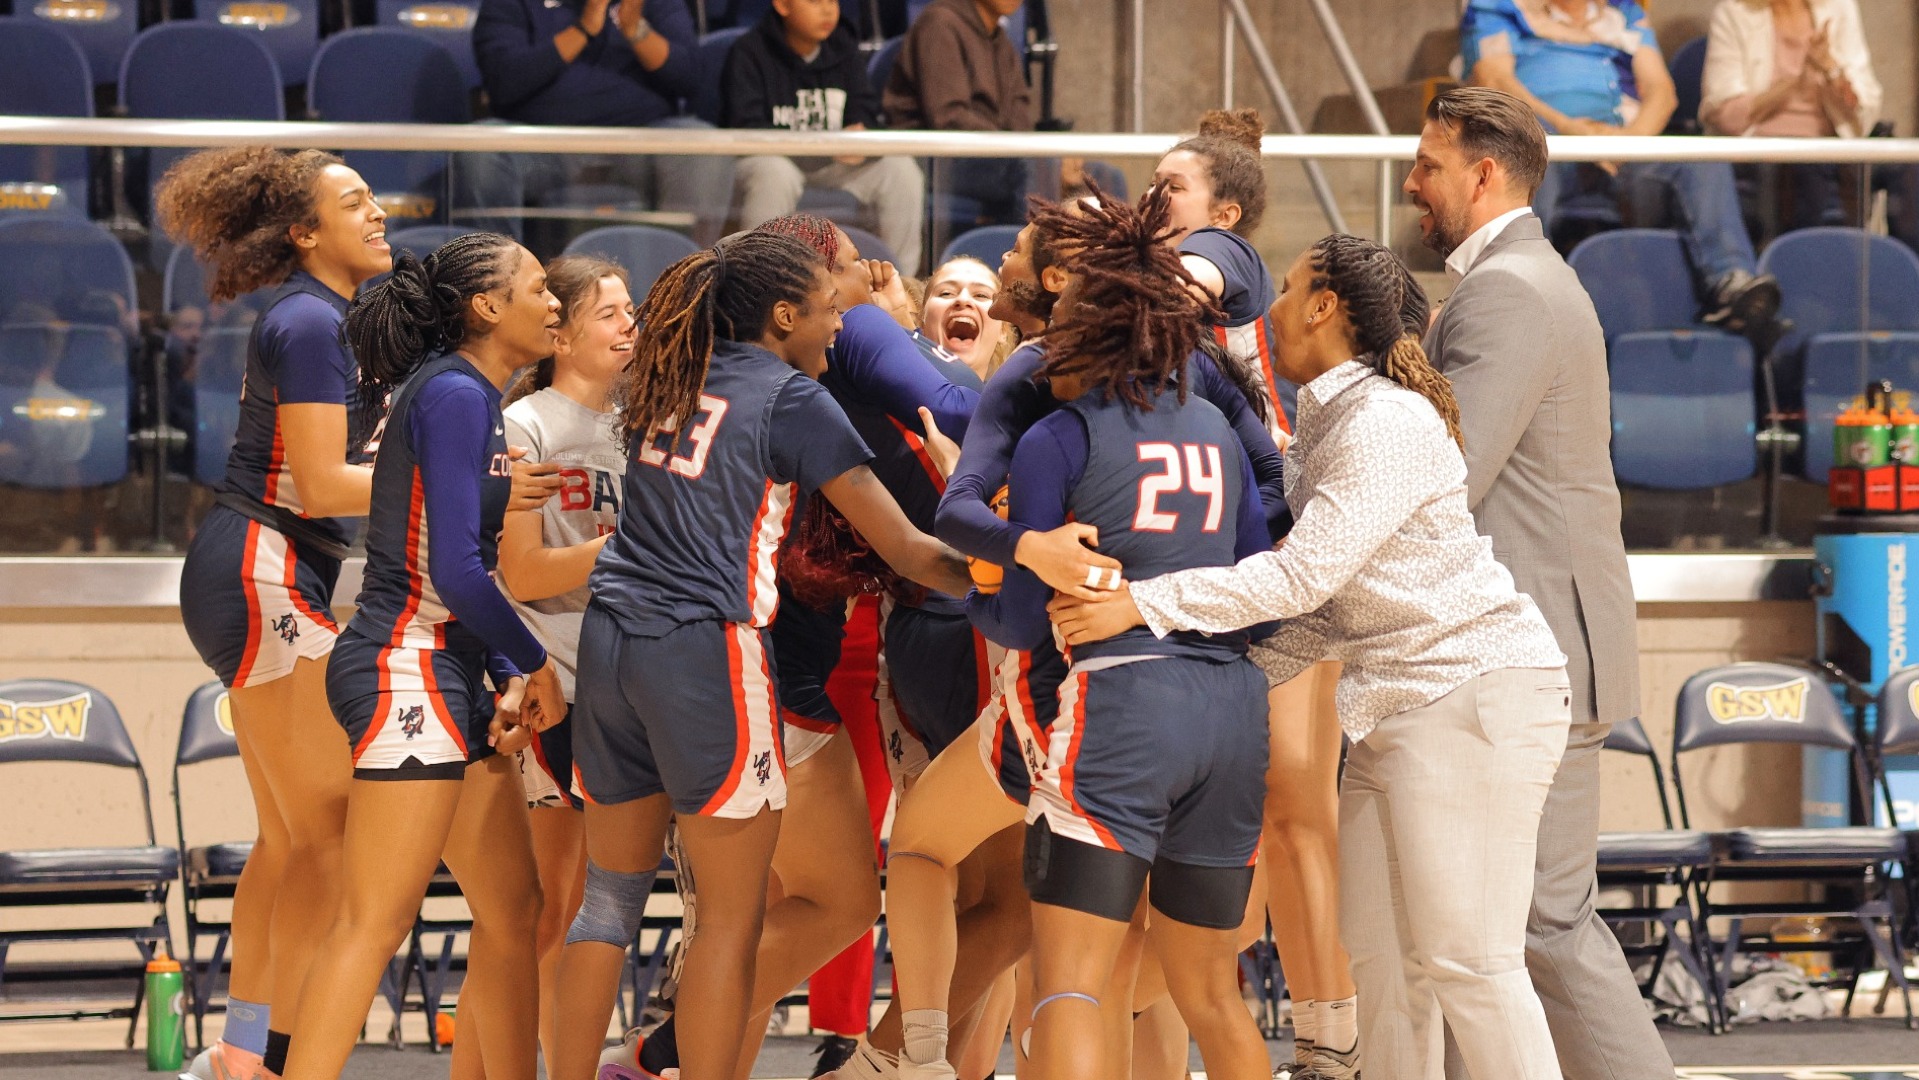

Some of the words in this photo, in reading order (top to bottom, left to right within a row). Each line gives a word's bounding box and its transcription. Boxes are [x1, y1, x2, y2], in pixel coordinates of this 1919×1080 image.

[638, 392, 729, 479] 23
[489, 453, 512, 477] CO
[1131, 440, 1225, 534] 24
[559, 468, 625, 514] BA
[1887, 544, 1907, 678] POWERADE
[0, 692, 91, 742] GSW
[1706, 677, 1810, 724] GSW
